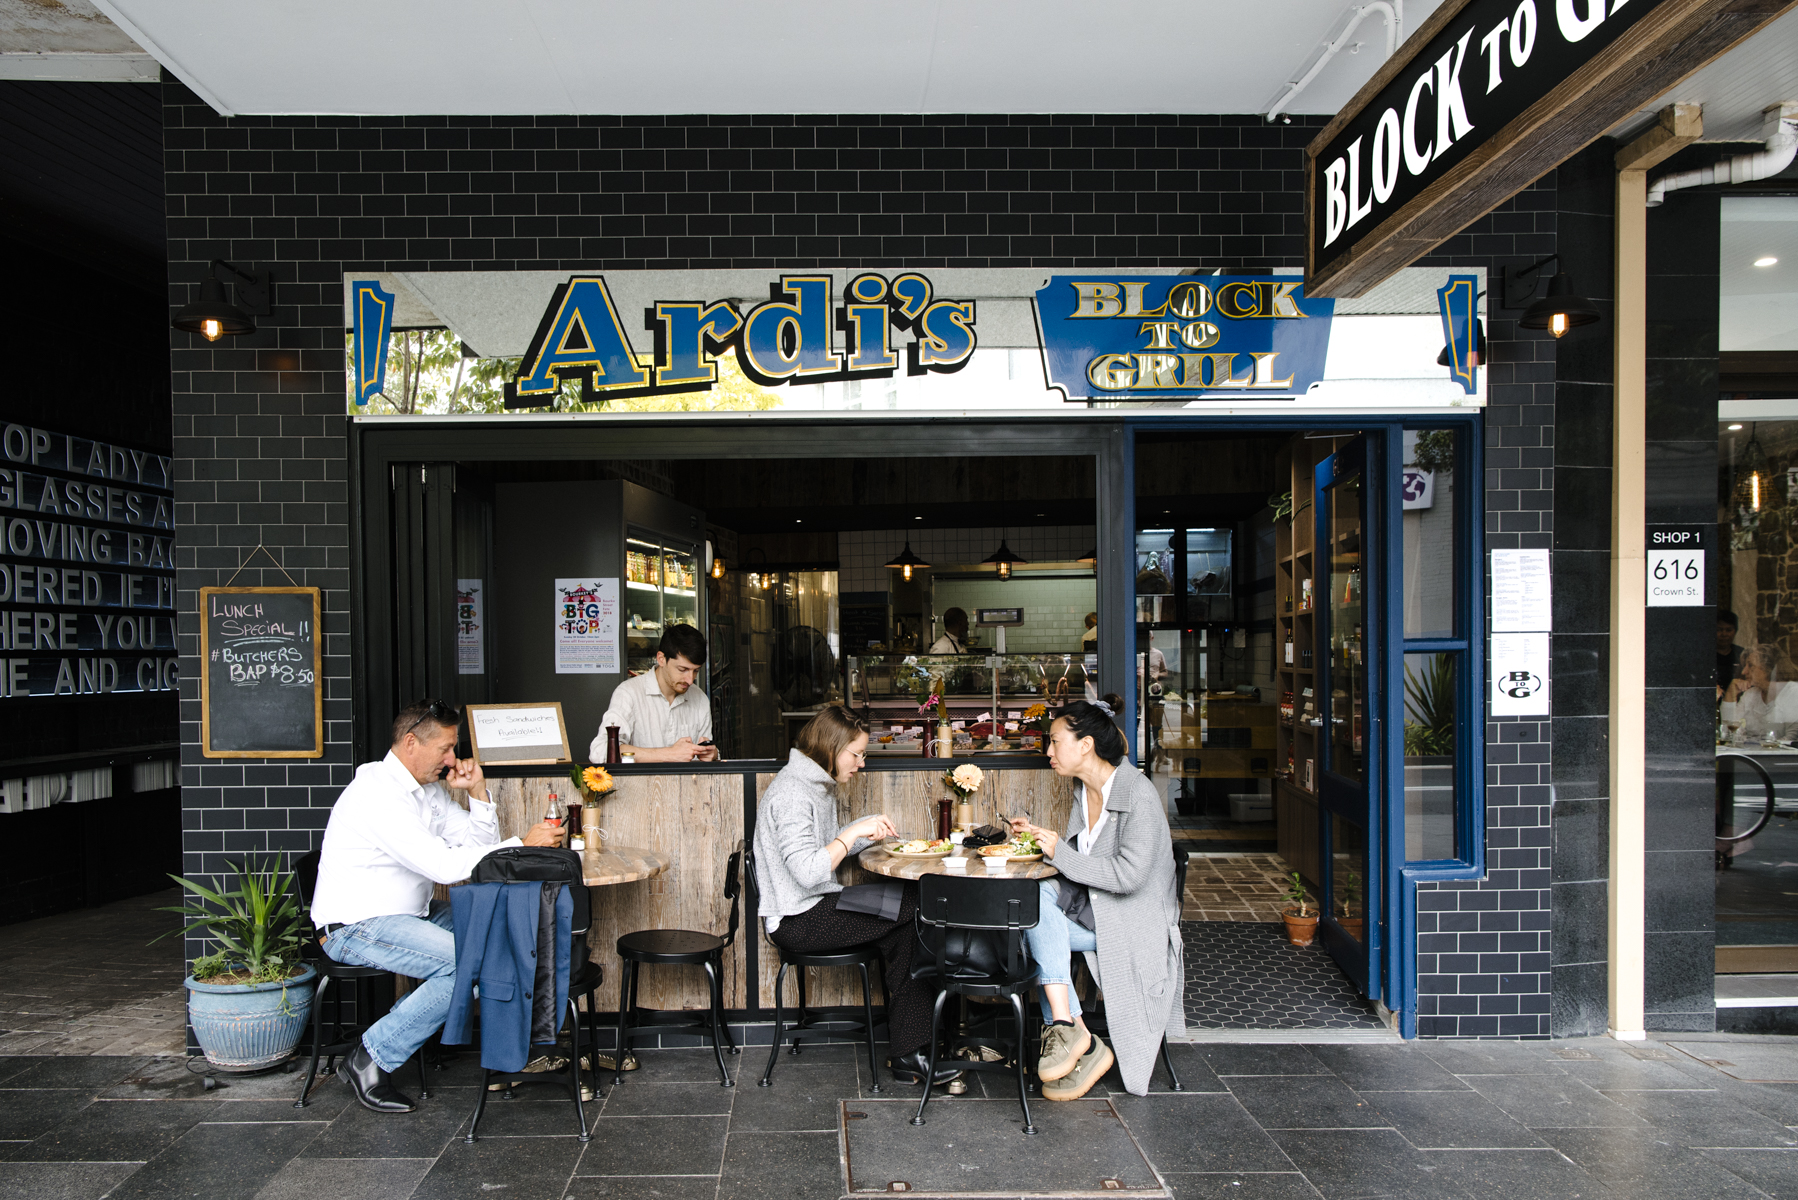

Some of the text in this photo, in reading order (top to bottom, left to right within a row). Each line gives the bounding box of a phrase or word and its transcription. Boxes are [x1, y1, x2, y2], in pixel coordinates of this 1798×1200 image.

[1323, 0, 1537, 249] BLOCK TO
[1068, 281, 1309, 318] BLOCK
[506, 272, 977, 407] Ardi's
[1139, 321, 1221, 349] TO
[1087, 352, 1295, 389] GRILL
[66, 434, 148, 484] LADY
[0, 468, 175, 531] GLASSES A
[0, 515, 112, 564] OVING
[1653, 532, 1700, 543] SHOP 1
[1653, 559, 1699, 580] 616
[121, 573, 143, 608] IF
[1653, 587, 1699, 596] Crown St.
[213, 597, 264, 619] LUNCH
[565, 603, 600, 619] BIG
[94, 614, 157, 651] YOU
[564, 619, 600, 635] TOP
[54, 657, 119, 695] AND
[230, 664, 267, 682] BAP
[1509, 671, 1531, 682] B
[1508, 687, 1531, 698] G
[477, 714, 556, 724] Fresh Sandwiches
